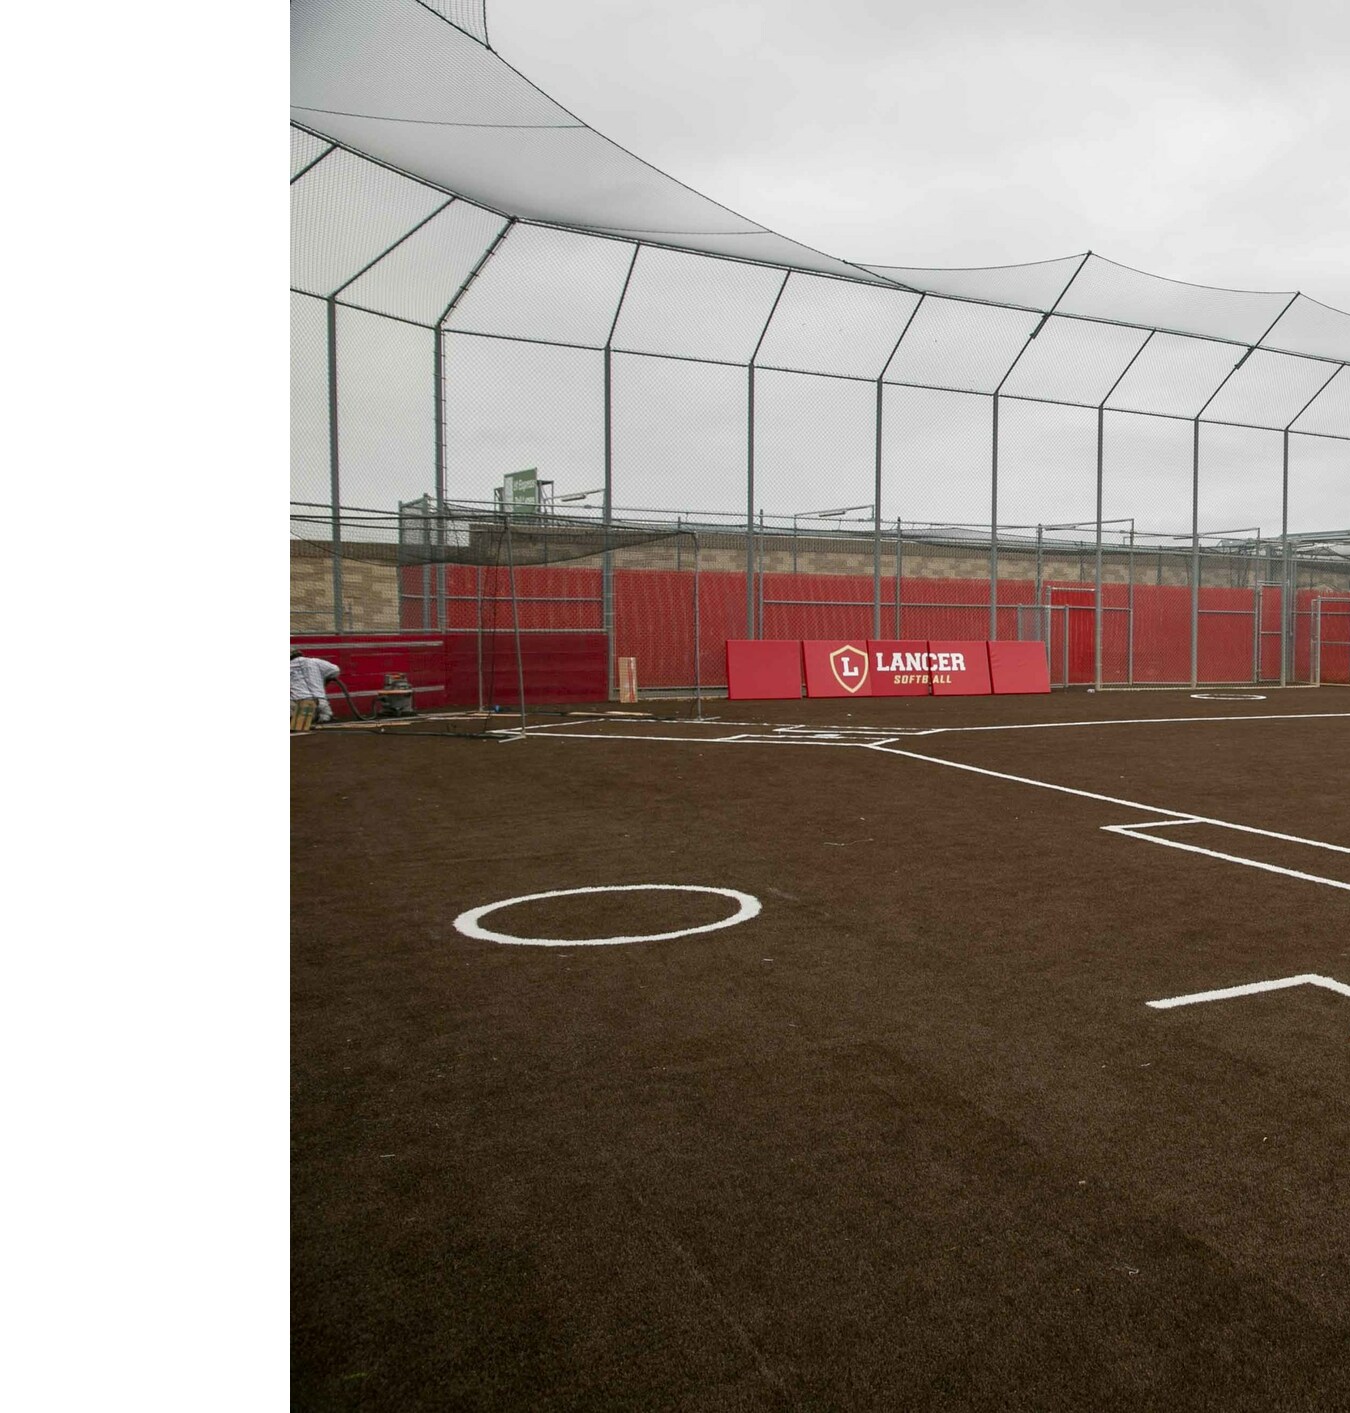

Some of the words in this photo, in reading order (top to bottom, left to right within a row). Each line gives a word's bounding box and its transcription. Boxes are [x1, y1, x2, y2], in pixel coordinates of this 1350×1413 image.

[841, 656, 859, 677] L
[875, 652, 966, 672] LANCER
[894, 674, 952, 685] SOFTBALL
